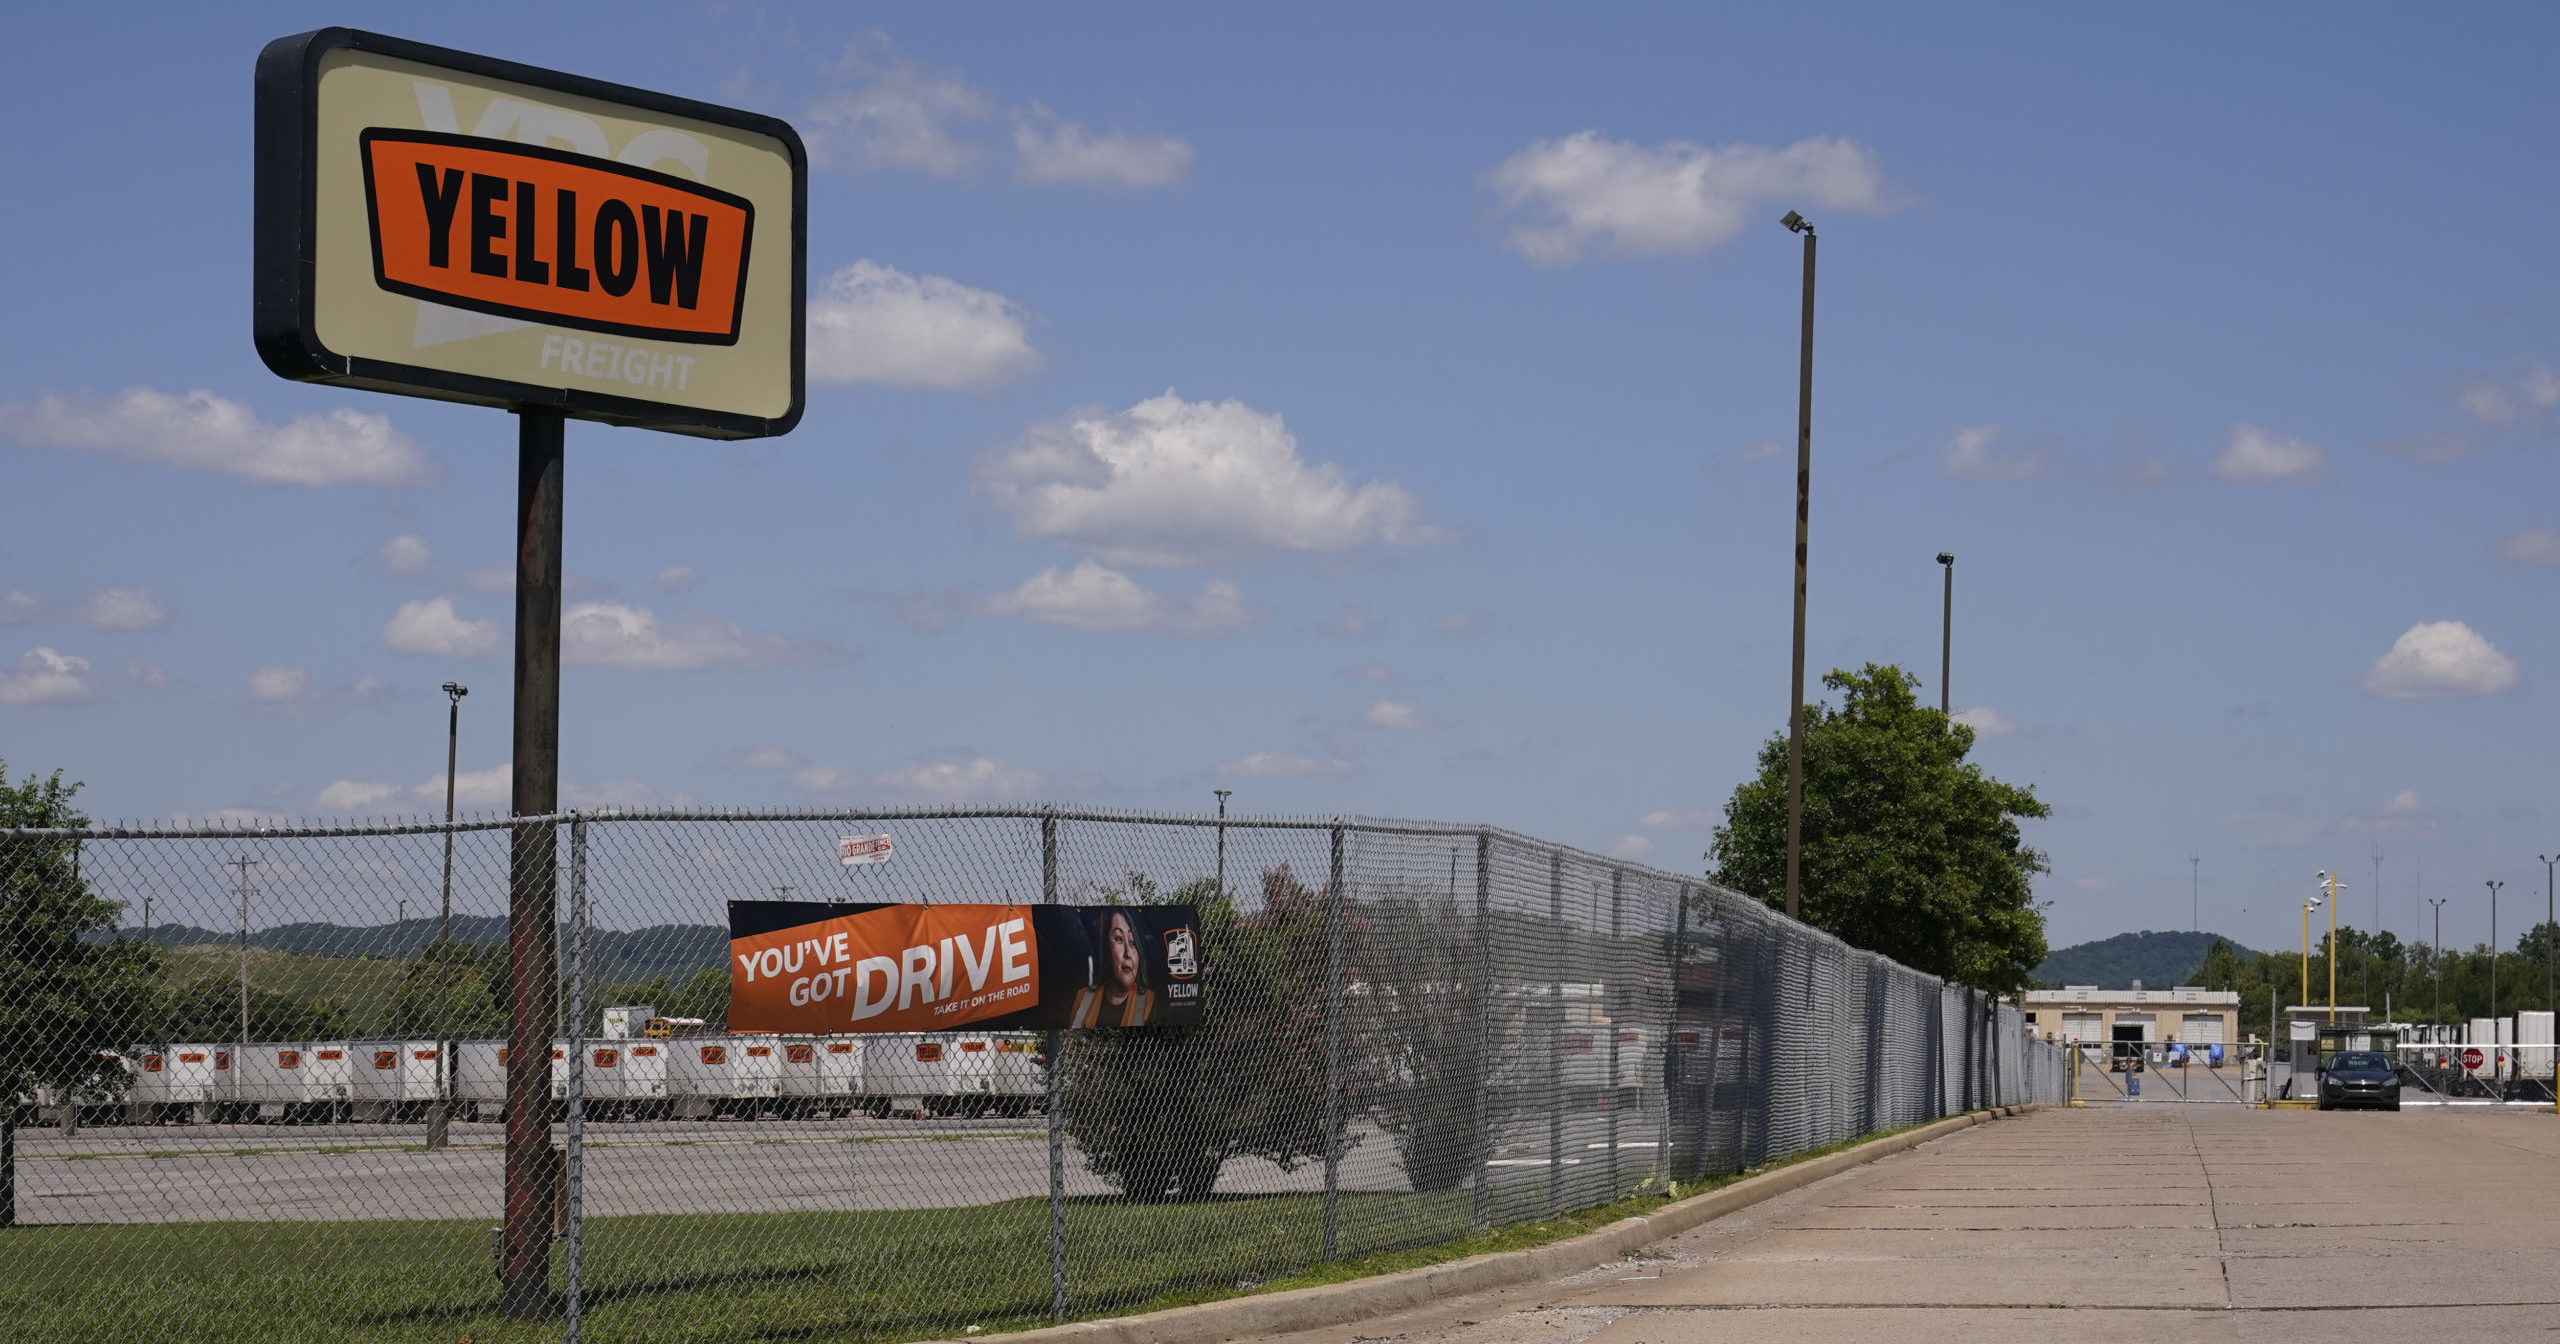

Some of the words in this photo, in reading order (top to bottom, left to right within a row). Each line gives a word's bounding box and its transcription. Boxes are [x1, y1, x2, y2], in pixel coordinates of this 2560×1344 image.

[414, 161, 709, 311] YELLOW
[540, 333, 697, 391] FREIGHT
[738, 931, 850, 983] YOU'VE
[851, 917, 1030, 1022] DRIVE
[789, 967, 852, 1007] GOT
[933, 1002, 958, 1016] TAKE
[960, 999, 969, 1010] IT
[971, 996, 986, 1007] ON
[987, 990, 1005, 1003] THE
[1006, 983, 1030, 998] ROAD
[1167, 983, 1199, 998] YELLOW
[2462, 1054, 2482, 1064] STOP
